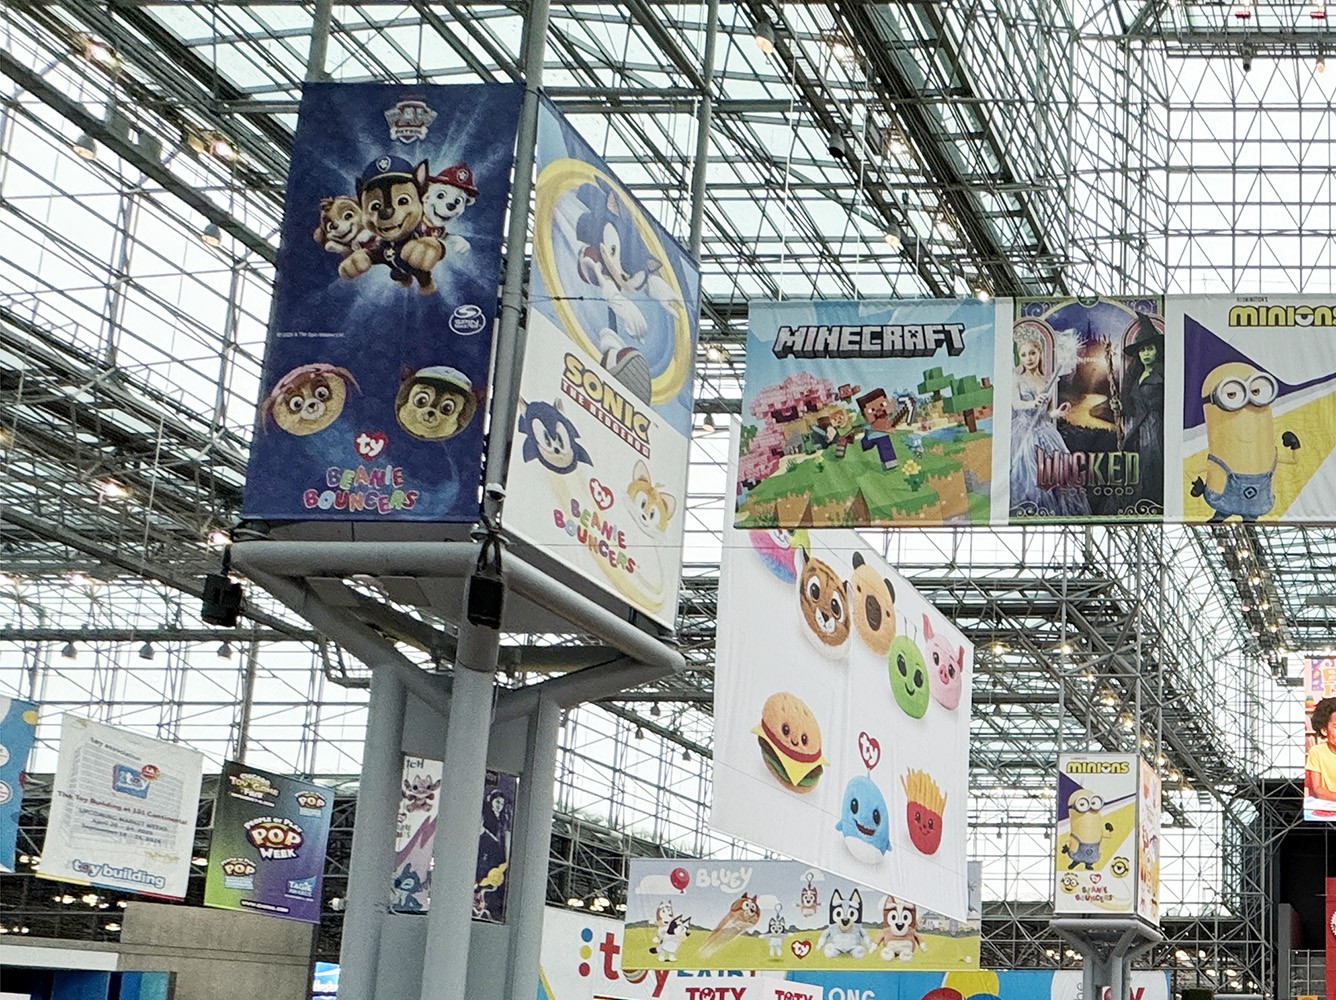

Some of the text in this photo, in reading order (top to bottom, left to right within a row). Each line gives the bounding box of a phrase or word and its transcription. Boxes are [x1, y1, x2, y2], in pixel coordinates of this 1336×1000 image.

[772, 323, 965, 358] MINECRAFT
[564, 352, 651, 446] SONIC
[356, 433, 384, 457] ty
[326, 465, 404, 490] BEANIE
[1036, 449, 1141, 492] WICKED
[303, 489, 419, 515] BOUNCERS
[592, 479, 614, 507] ty
[1093, 486, 1134, 496] GOOD
[570, 498, 627, 549] BEANIE
[553, 508, 636, 574] BOUNCERS
[861, 736, 879, 763] ty
[299, 796, 326, 808] POP
[251, 828, 302, 846] POP
[259, 847, 298, 860] WEEK
[101, 864, 166, 889] building
[224, 863, 256, 876] POP
[695, 867, 753, 894] BLUEY
[793, 941, 810, 956] ty
